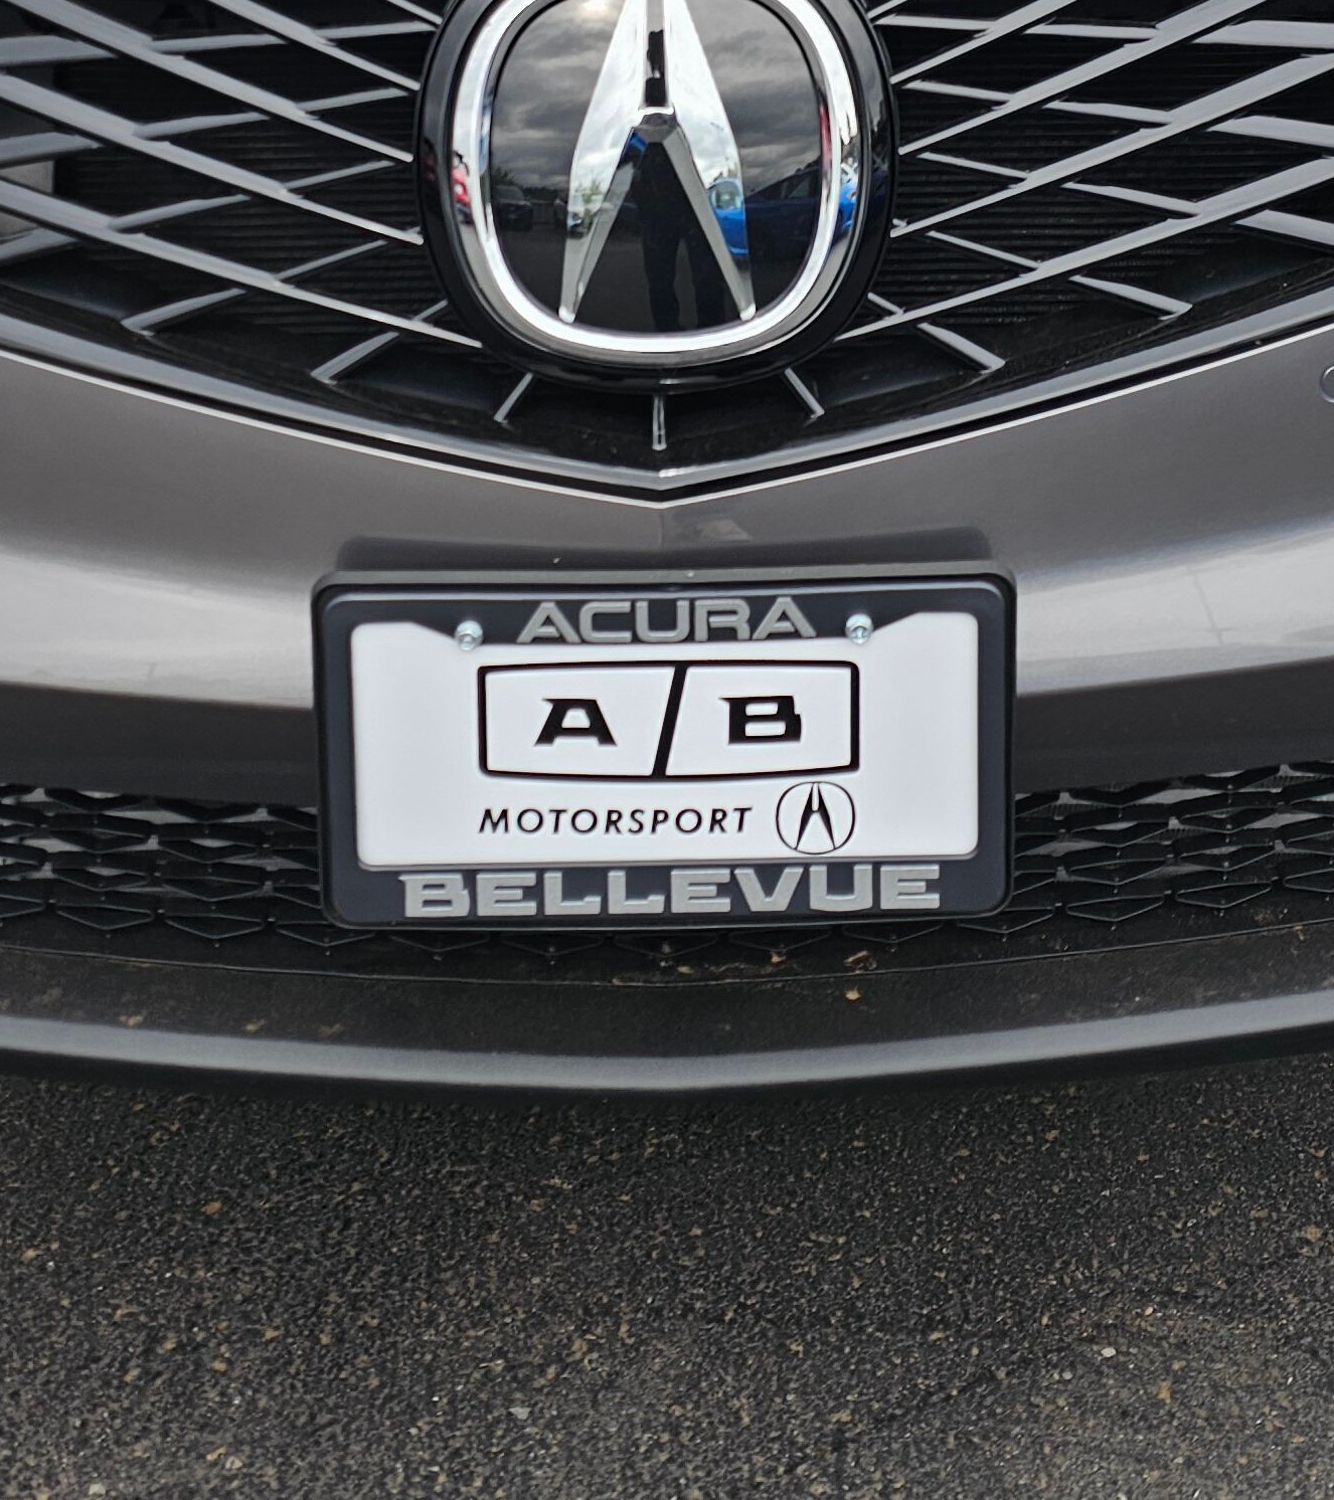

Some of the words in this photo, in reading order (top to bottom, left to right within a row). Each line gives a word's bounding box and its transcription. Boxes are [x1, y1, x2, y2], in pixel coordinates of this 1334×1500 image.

[516, 596, 817, 644] ACURA
[478, 806, 752, 835] MOTORSPORT
[398, 864, 941, 917] BELLEVUE
